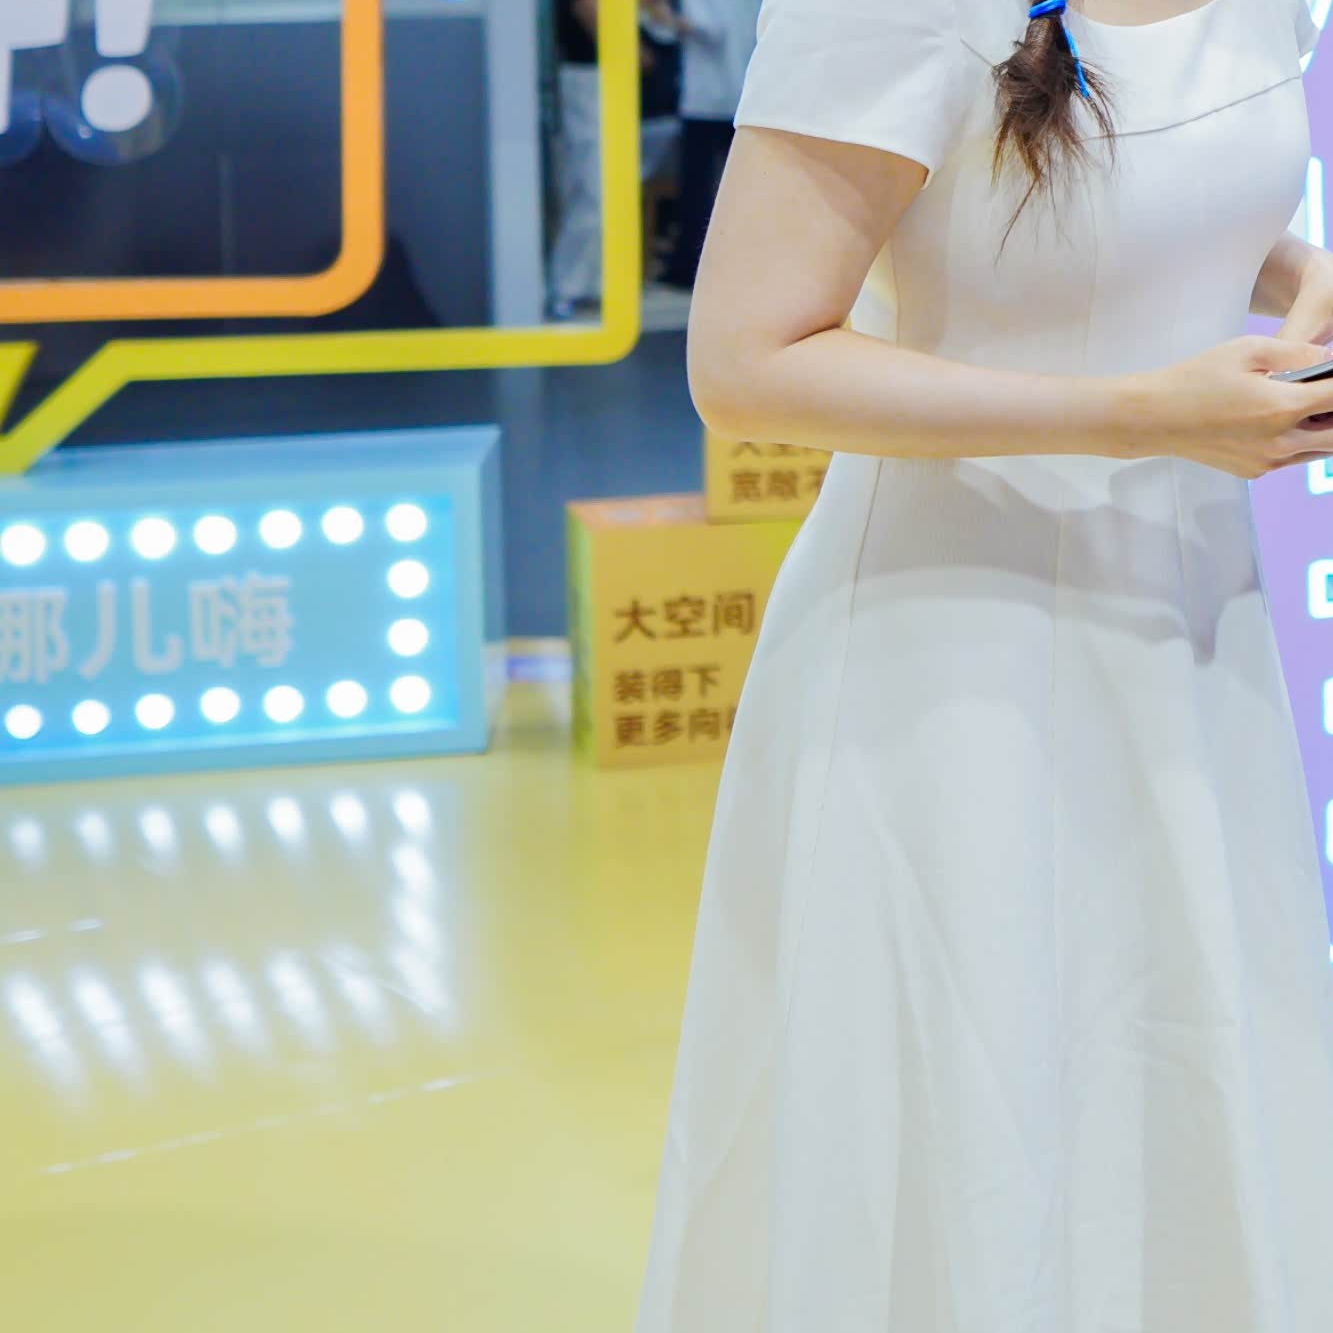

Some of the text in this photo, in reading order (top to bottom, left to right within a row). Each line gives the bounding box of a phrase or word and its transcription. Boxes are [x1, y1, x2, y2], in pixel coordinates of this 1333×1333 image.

[612, 590, 757, 645] 大空间
[613, 707, 738, 750] 更多向
